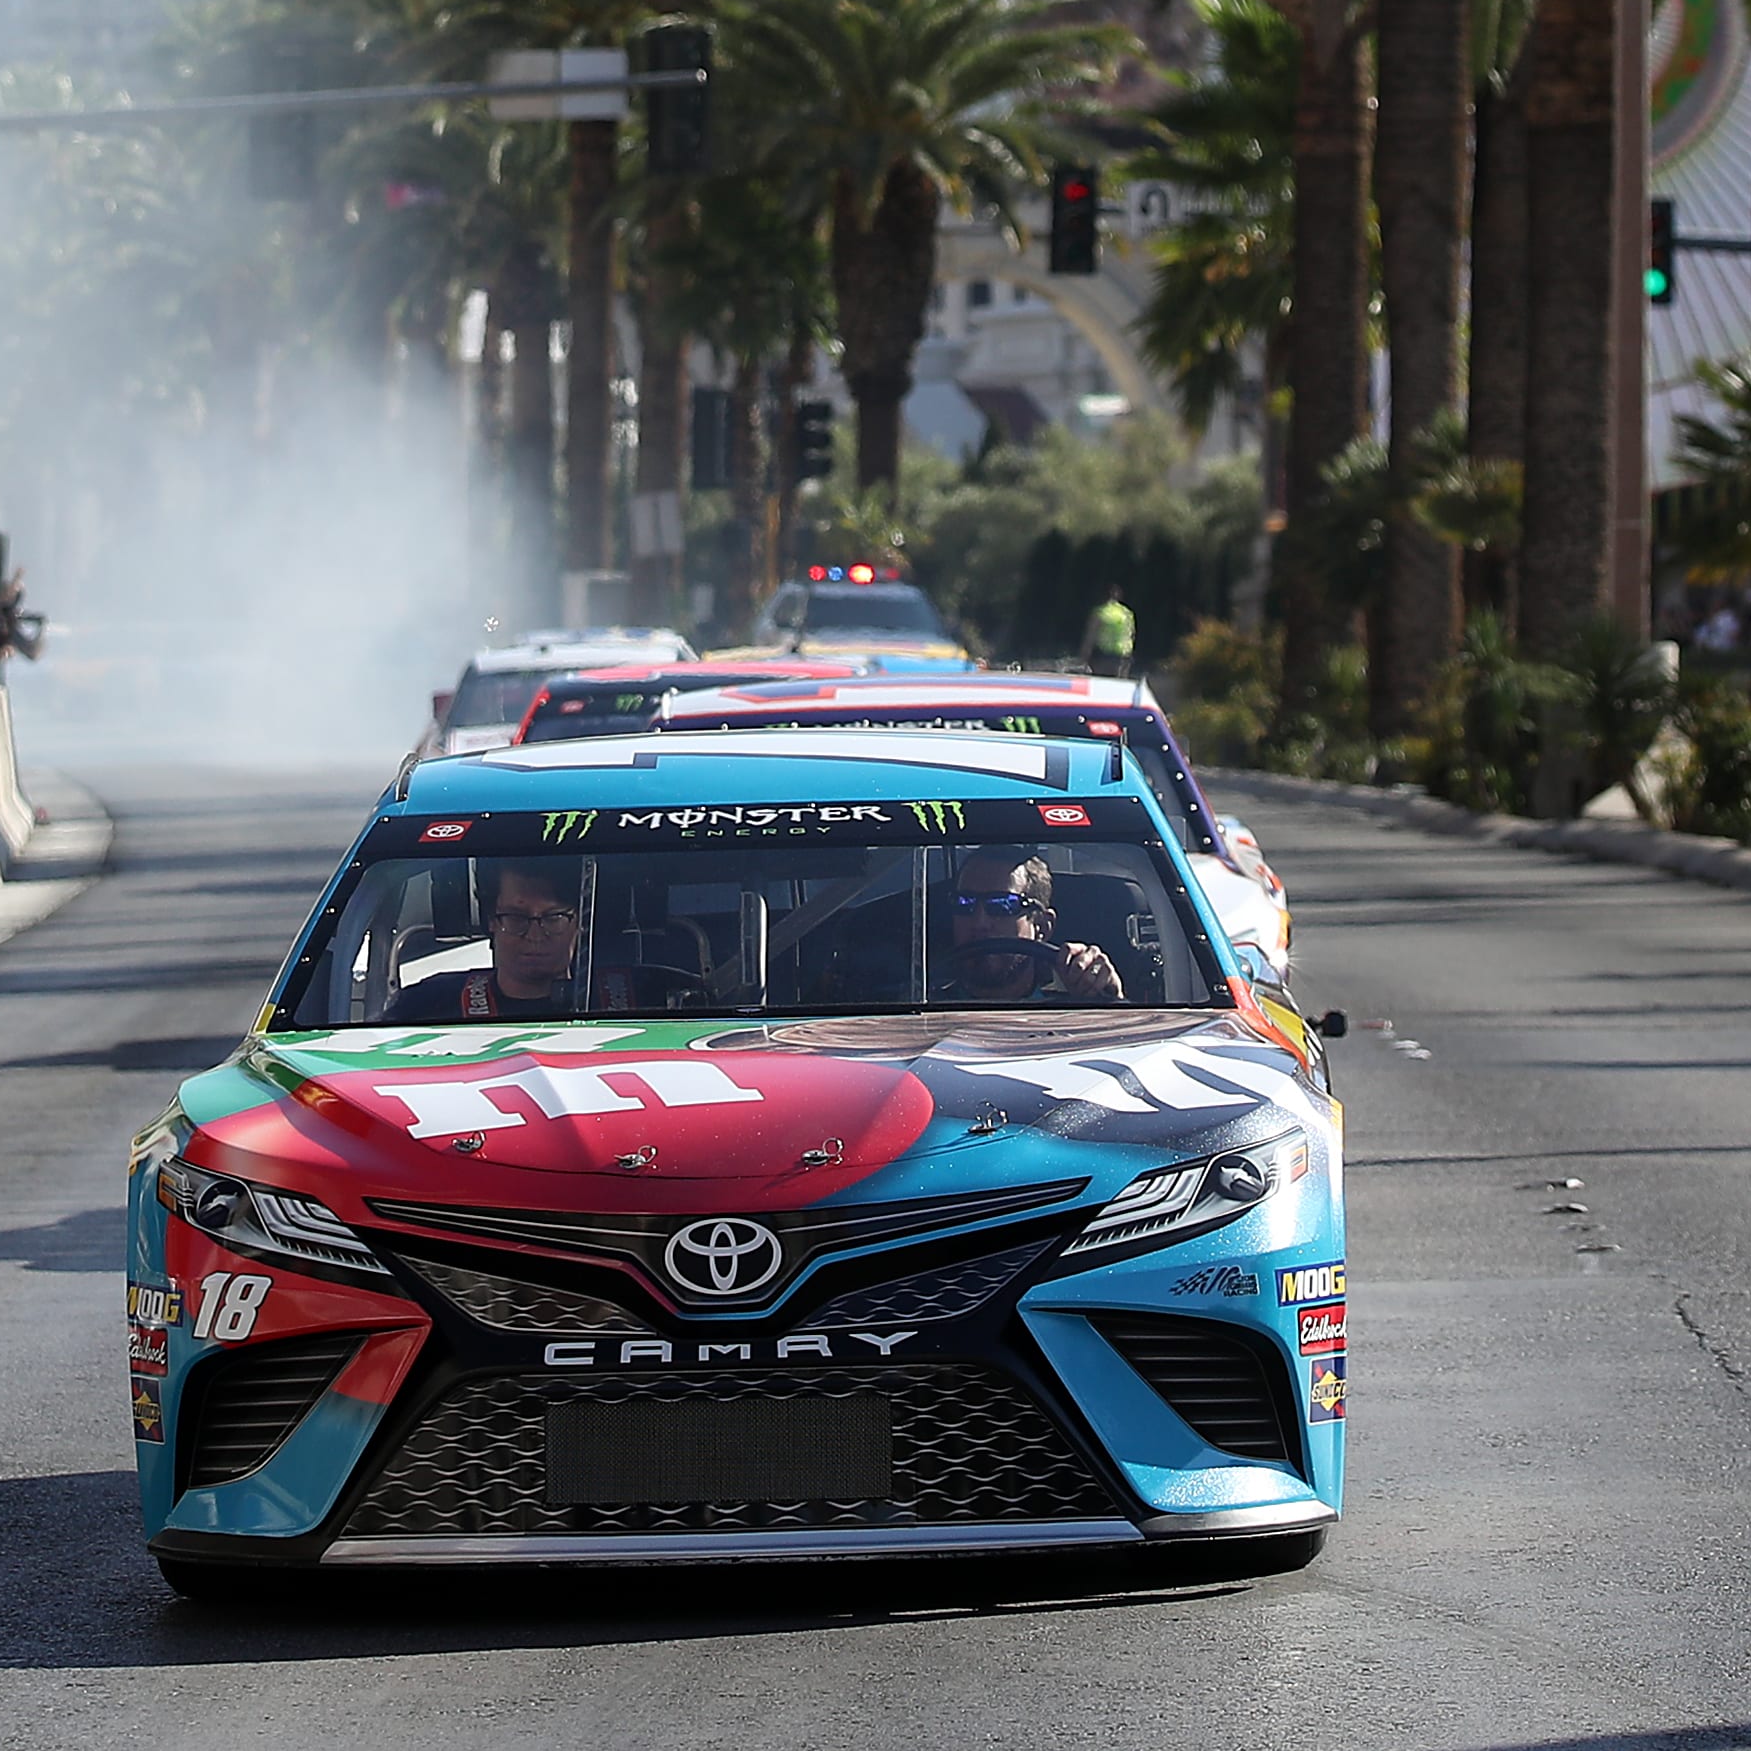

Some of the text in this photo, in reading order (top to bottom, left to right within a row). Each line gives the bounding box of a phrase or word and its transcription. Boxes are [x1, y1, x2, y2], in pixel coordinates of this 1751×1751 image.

[617, 804, 893, 830] MONSTER
[680, 826, 831, 838] ENERGY
[1280, 1264, 1346, 1303] MOOG
[193, 1272, 273, 1341] 18
[544, 1330, 919, 1366] CAMRY
